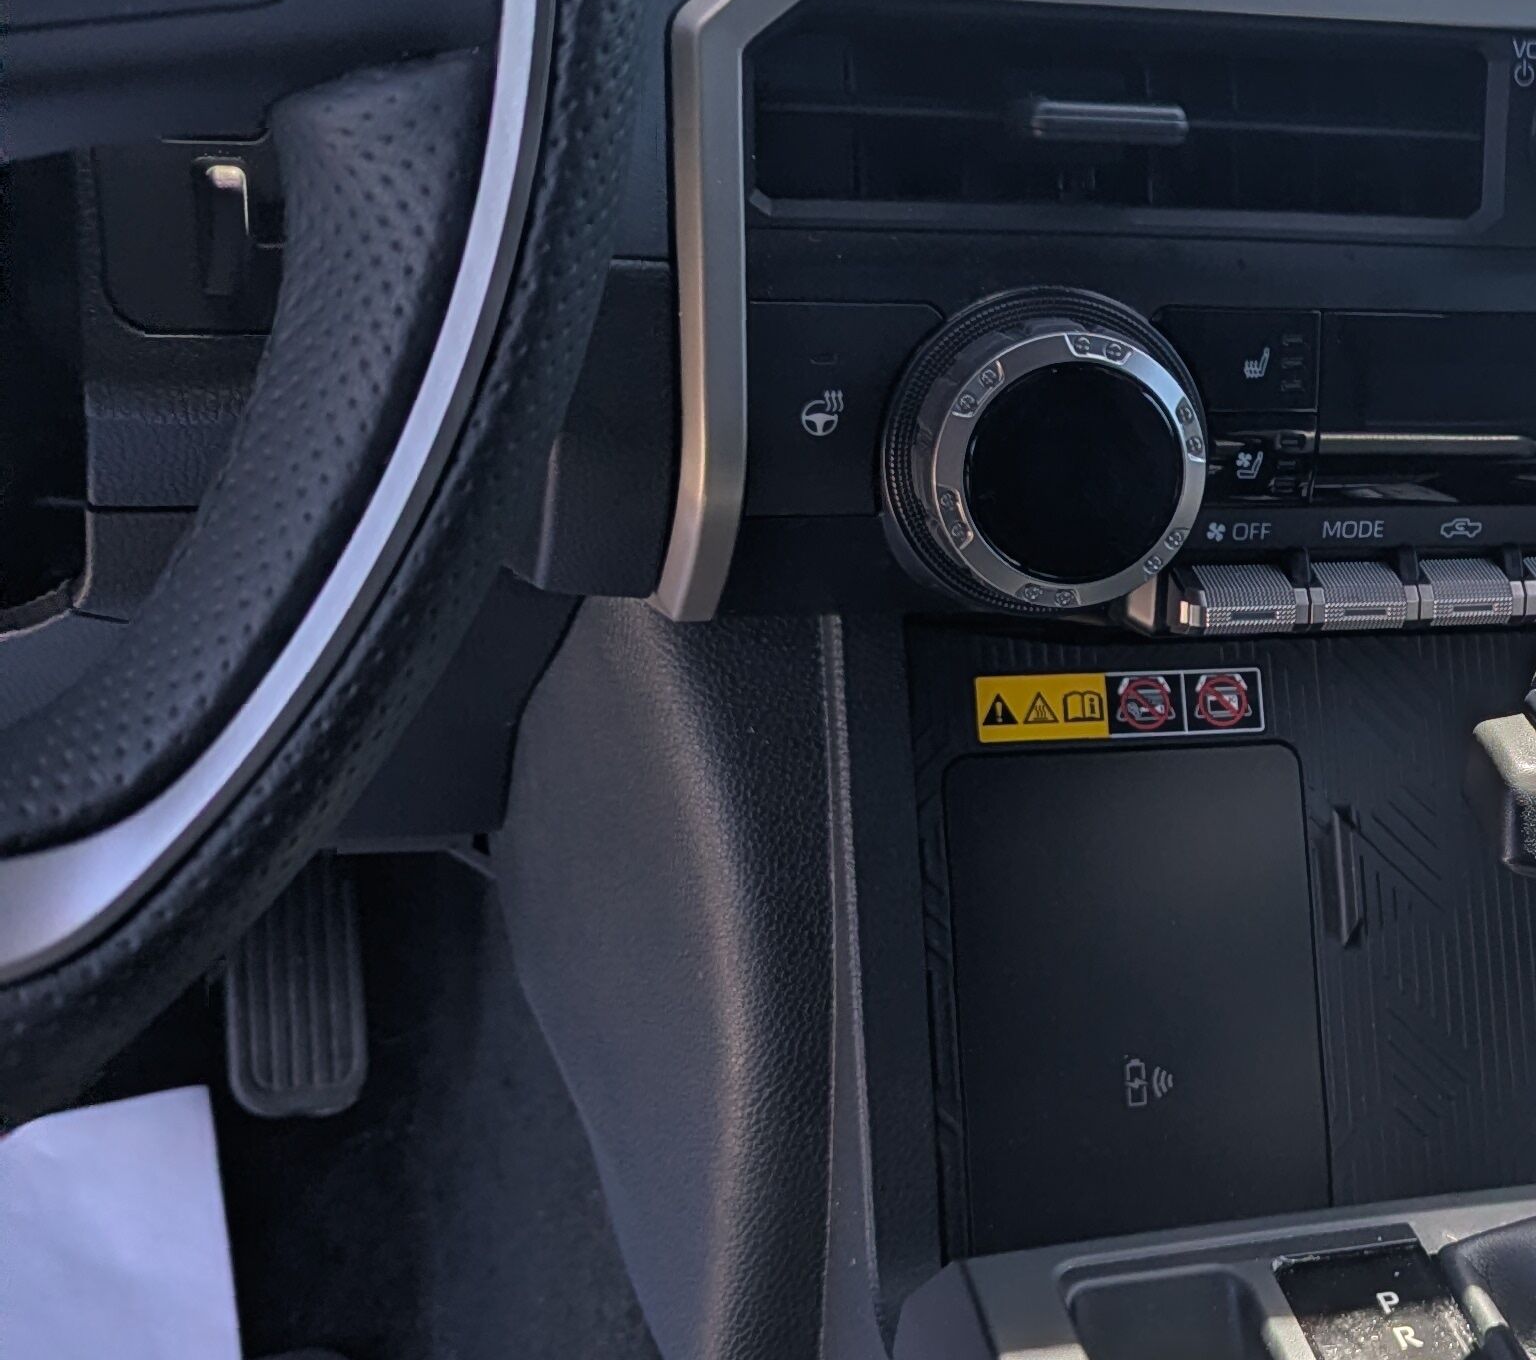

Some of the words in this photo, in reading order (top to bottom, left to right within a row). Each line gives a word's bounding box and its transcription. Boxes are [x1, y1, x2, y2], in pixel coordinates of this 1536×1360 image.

[1231, 522, 1272, 541] OFF
[1322, 520, 1385, 539] MODE
[1376, 1291, 1399, 1315] P
[1393, 1325, 1424, 1351] R
